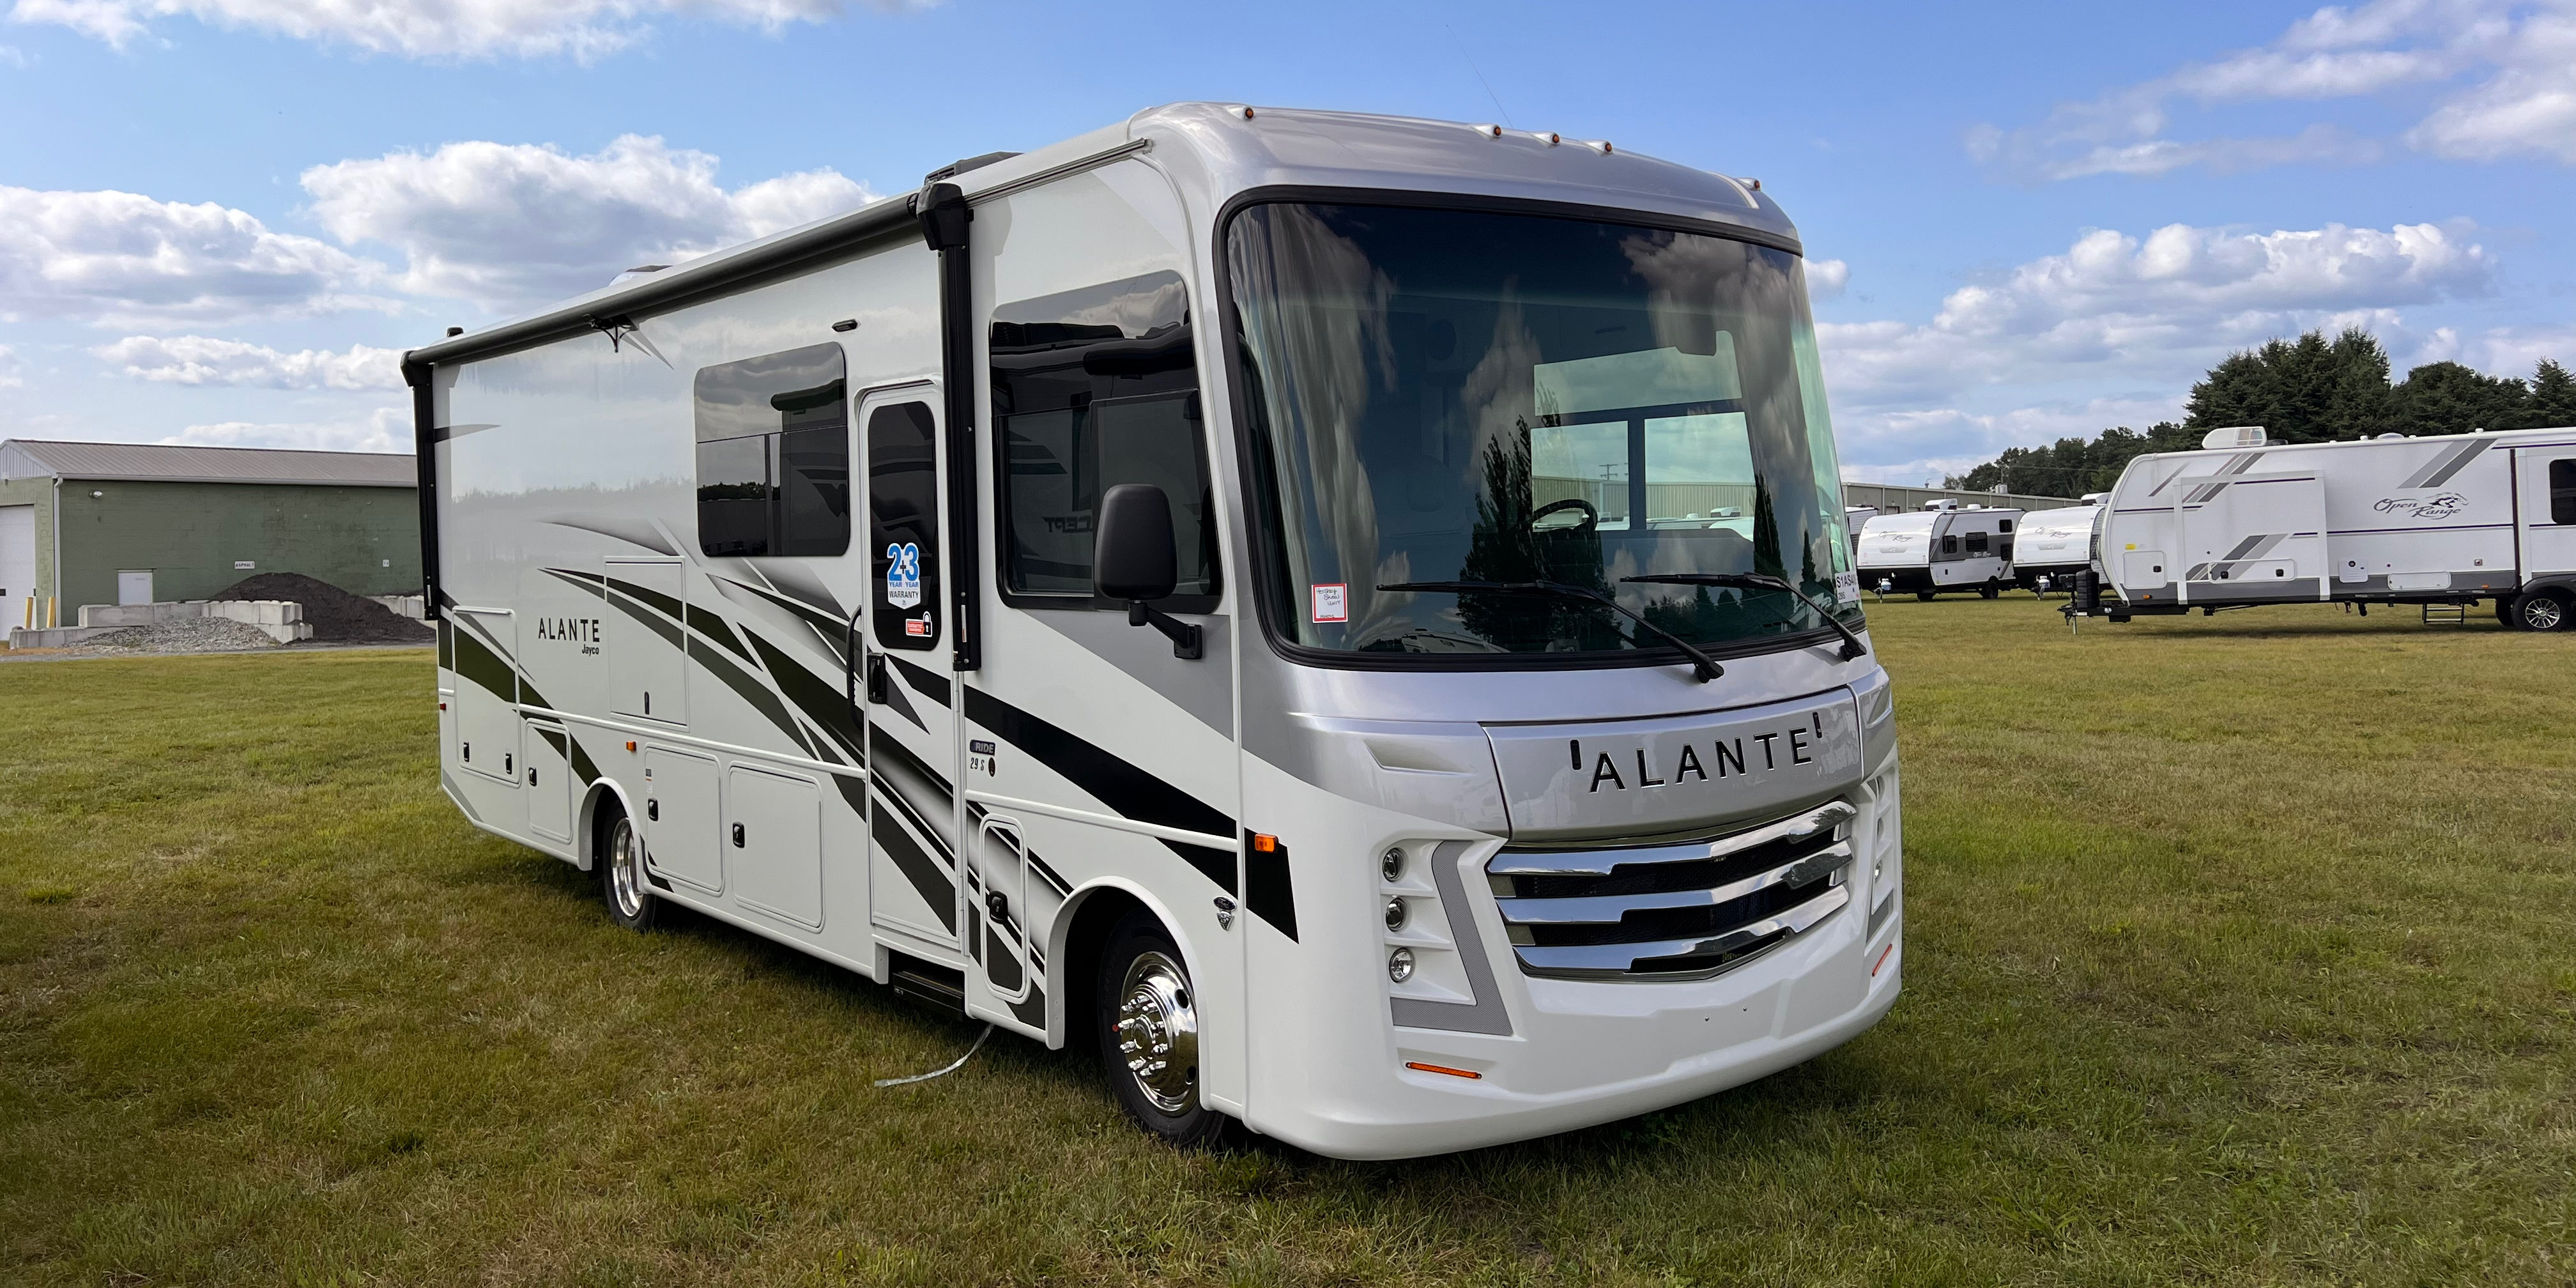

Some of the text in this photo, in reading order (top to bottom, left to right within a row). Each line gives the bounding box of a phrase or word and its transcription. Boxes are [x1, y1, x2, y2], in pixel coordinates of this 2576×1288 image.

[2373, 498, 2419, 514] Open
[2407, 506, 2462, 520] Range
[889, 590, 919, 599] WARRANTY
[539, 617, 600, 643] ALANTE
[581, 643, 599, 657] Jayco
[1588, 727, 1813, 794] ALANTE
